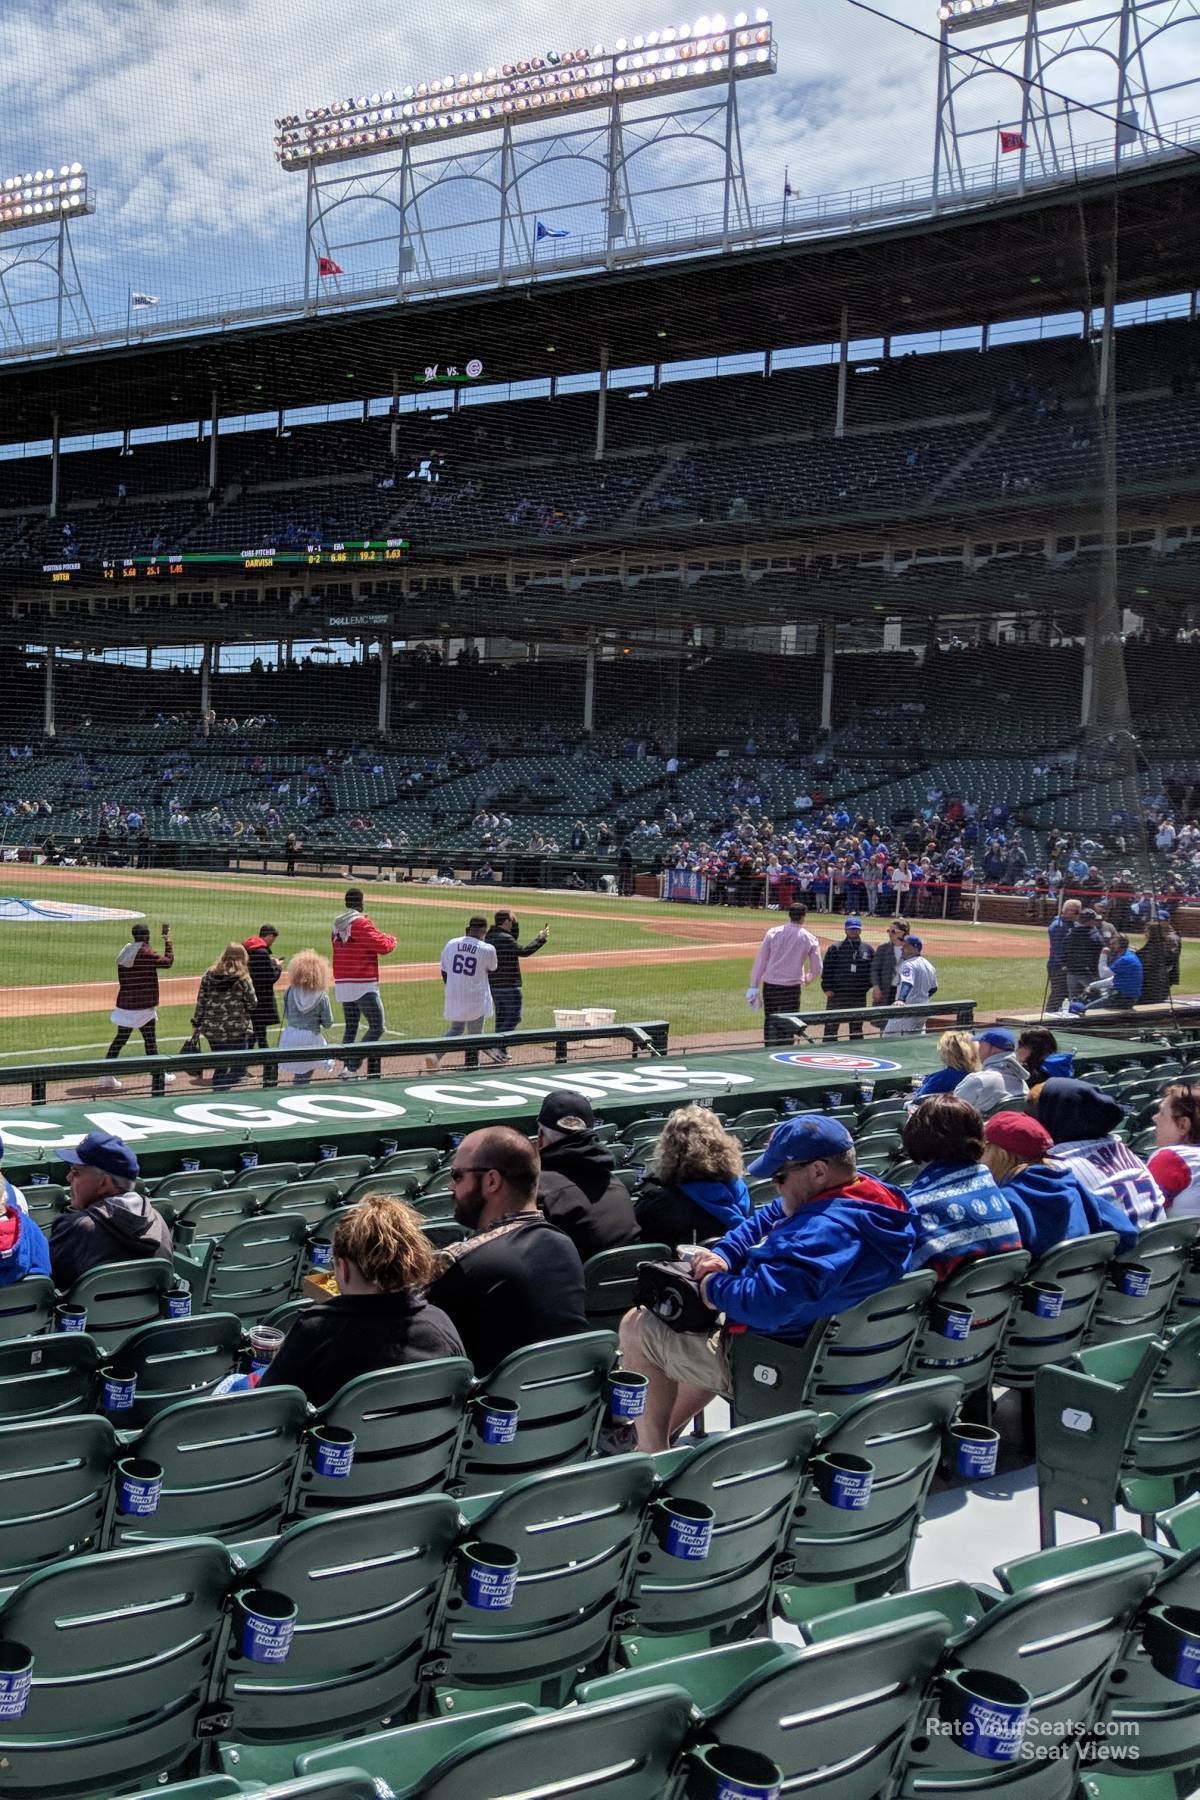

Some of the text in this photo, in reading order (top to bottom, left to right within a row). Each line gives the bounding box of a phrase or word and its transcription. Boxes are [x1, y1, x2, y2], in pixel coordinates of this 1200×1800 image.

[360, 550, 376, 560] 19.2
[245, 558, 273, 568] DARVISH
[52, 572, 70, 581] SUTER
[329, 616, 350, 626] DELL
[350, 616, 368, 625] EMC
[458, 944, 478, 954] LORD
[452, 954, 478, 976] 69
[404, 1066, 755, 1107] CUBS
[762, 1370, 768, 1380] 6
[1073, 1412, 1082, 1425] 7
[672, 1520, 696, 1534] Hefty
[473, 1572, 497, 1583] Hefty
[482, 1585, 506, 1594] Hefty
[250, 1620, 274, 1632] Hefty
[258, 1636, 281, 1646] Hefty
[1, 1703, 23, 1713] Hefty
